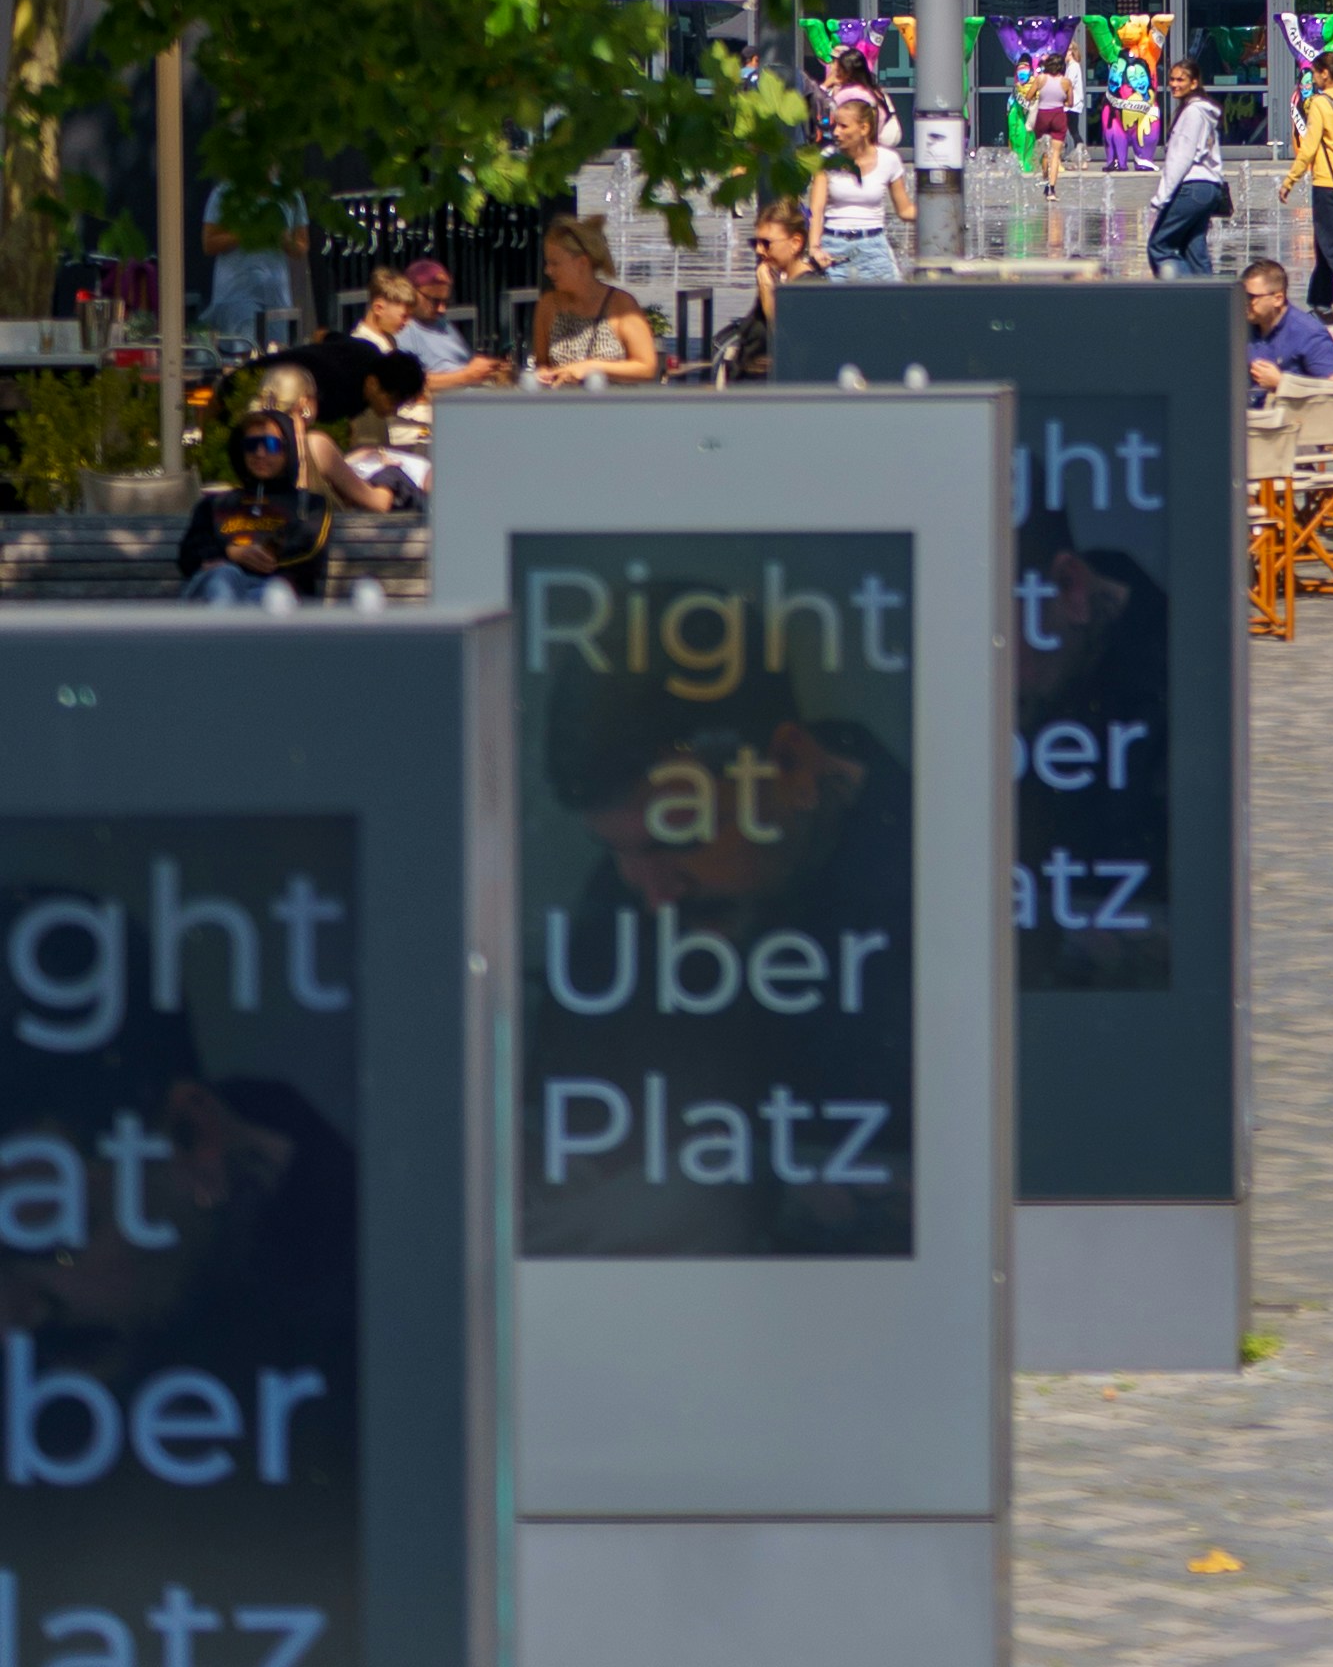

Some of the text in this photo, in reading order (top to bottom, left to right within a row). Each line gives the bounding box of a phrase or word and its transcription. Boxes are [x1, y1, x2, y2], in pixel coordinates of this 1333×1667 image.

[1010, 419, 1164, 529] ht
[524, 560, 909, 698] Right
[644, 745, 780, 845] at
[1010, 719, 1150, 791] er
[544, 904, 888, 1014] Uber
[0, 1108, 181, 1251] at
[541, 1073, 894, 1185] Platz
